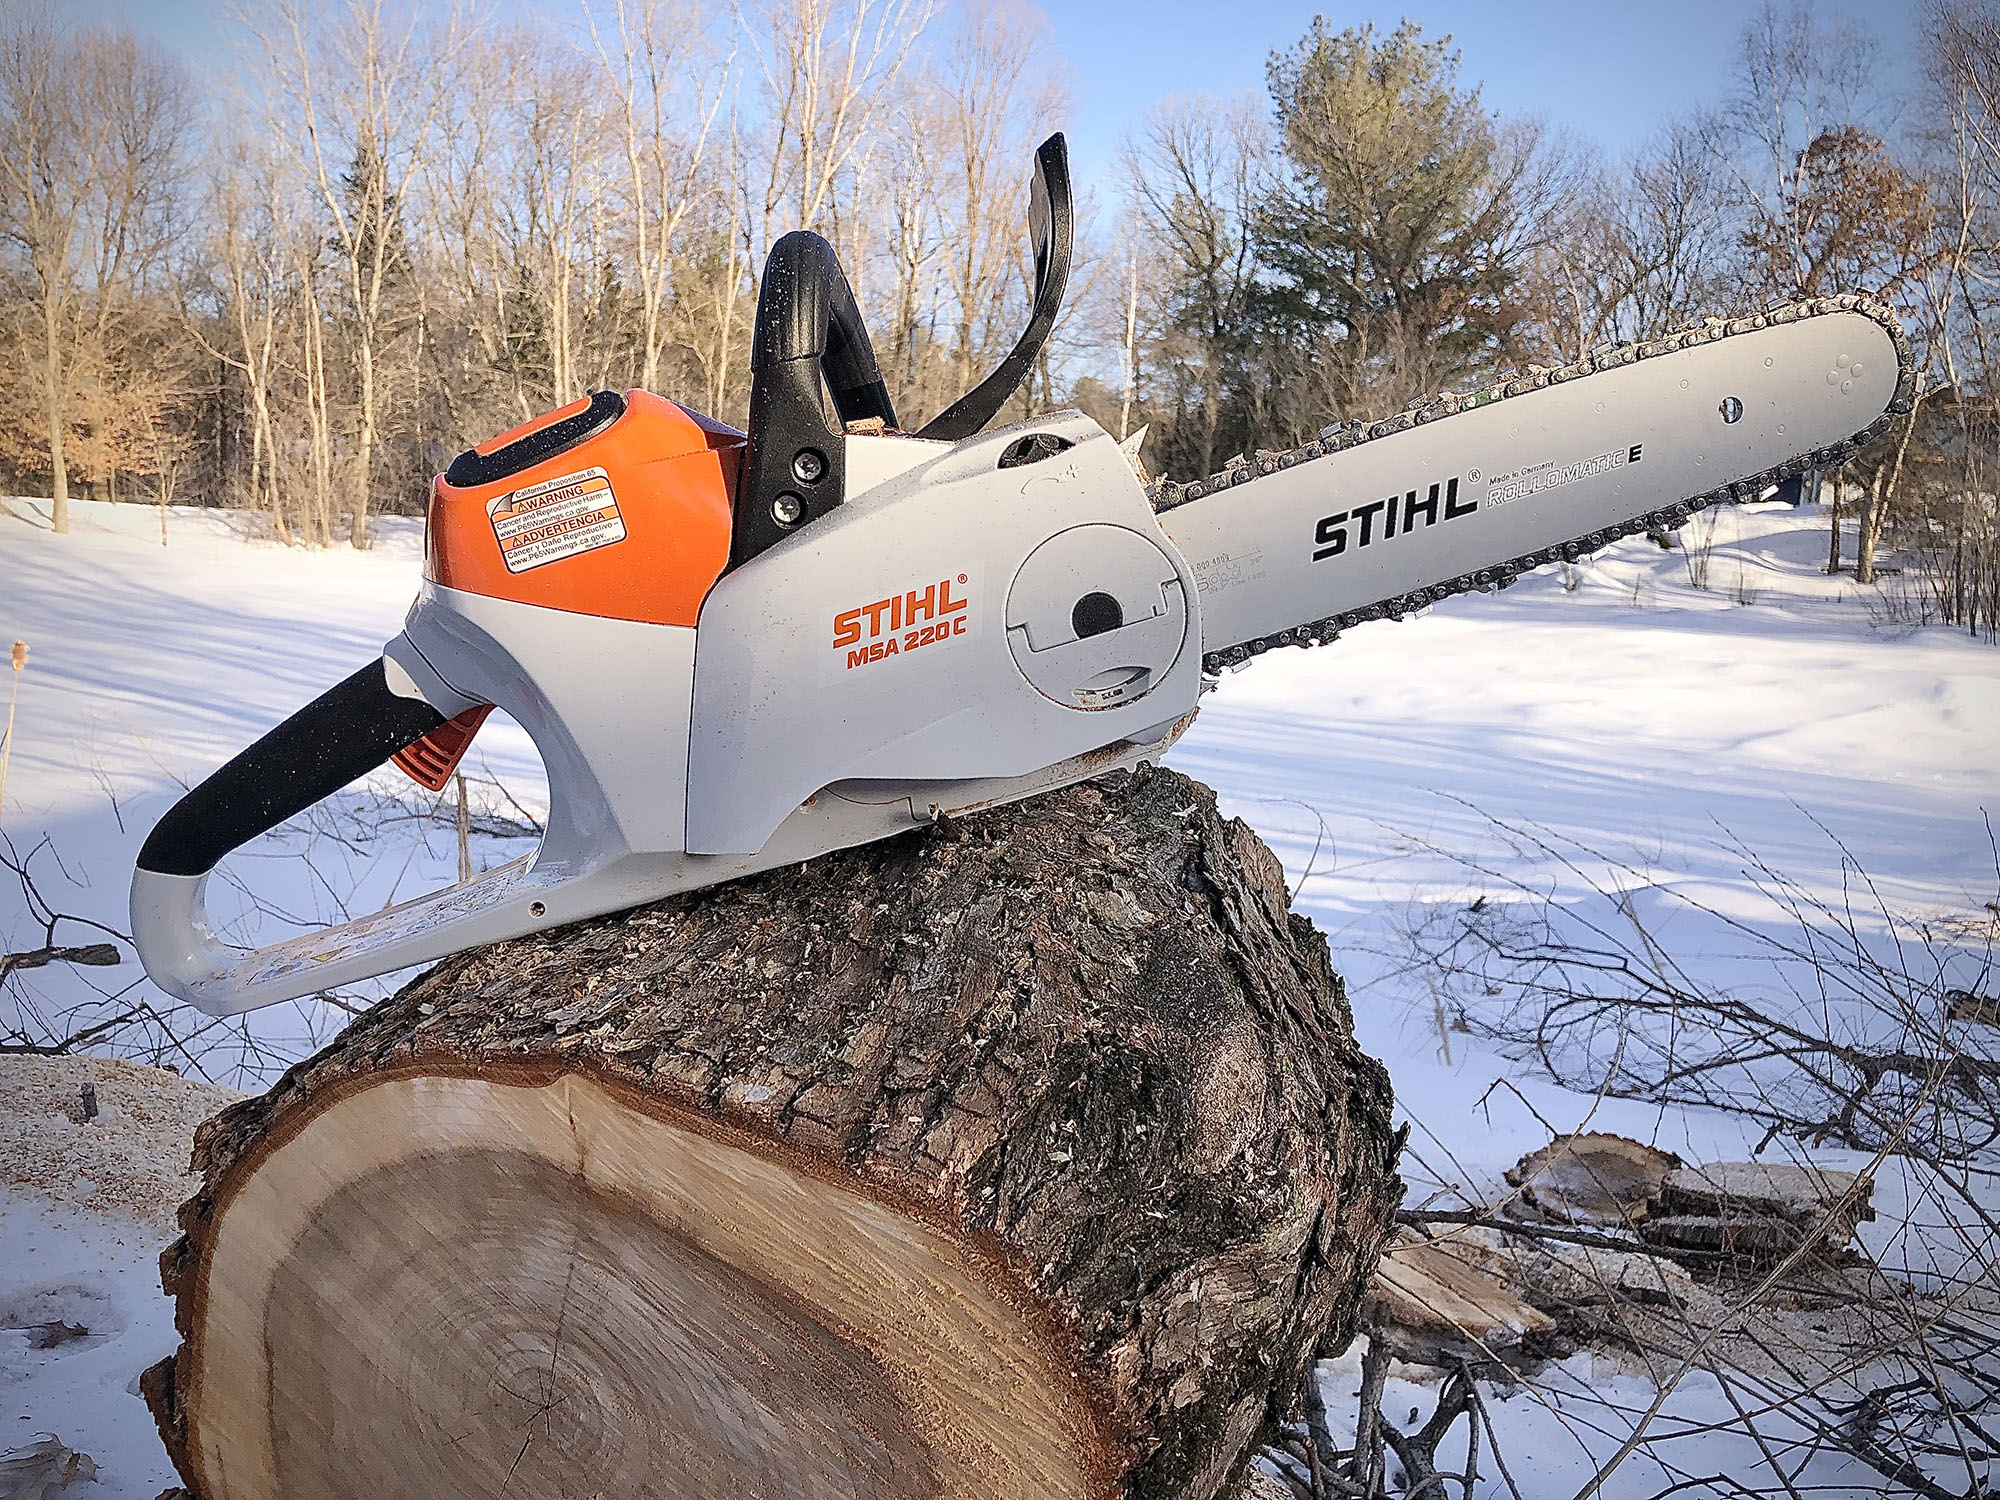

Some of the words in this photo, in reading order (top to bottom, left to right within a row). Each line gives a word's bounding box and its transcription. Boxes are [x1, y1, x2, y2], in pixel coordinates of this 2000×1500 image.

[516, 484, 548, 500] California
[548, 472, 586, 490] Proposition
[587, 469, 596, 478] 65
[1487, 449, 1626, 508] ROLLOMATIC
[1628, 444, 1643, 464] E
[1489, 476, 1510, 486] Made
[1512, 470, 1519, 478] in
[1521, 460, 1555, 476] Germany
[496, 518, 522, 531] Cancer
[522, 512, 536, 524] and
[536, 498, 582, 518] Reproductive
[582, 492, 603, 504] Harm
[528, 485, 584, 510] WARNING
[523, 511, 606, 545] ADVERTENCIA
[1312, 476, 1479, 563] STIHL
[508, 546, 534, 560] Cáncer
[536, 545, 540, 553] y
[542, 536, 562, 549] Daño
[564, 522, 613, 542] Reproductivo
[833, 580, 968, 650] STIHL
[847, 638, 900, 670] MSA
[904, 621, 950, 652] 220
[953, 615, 968, 636] C
